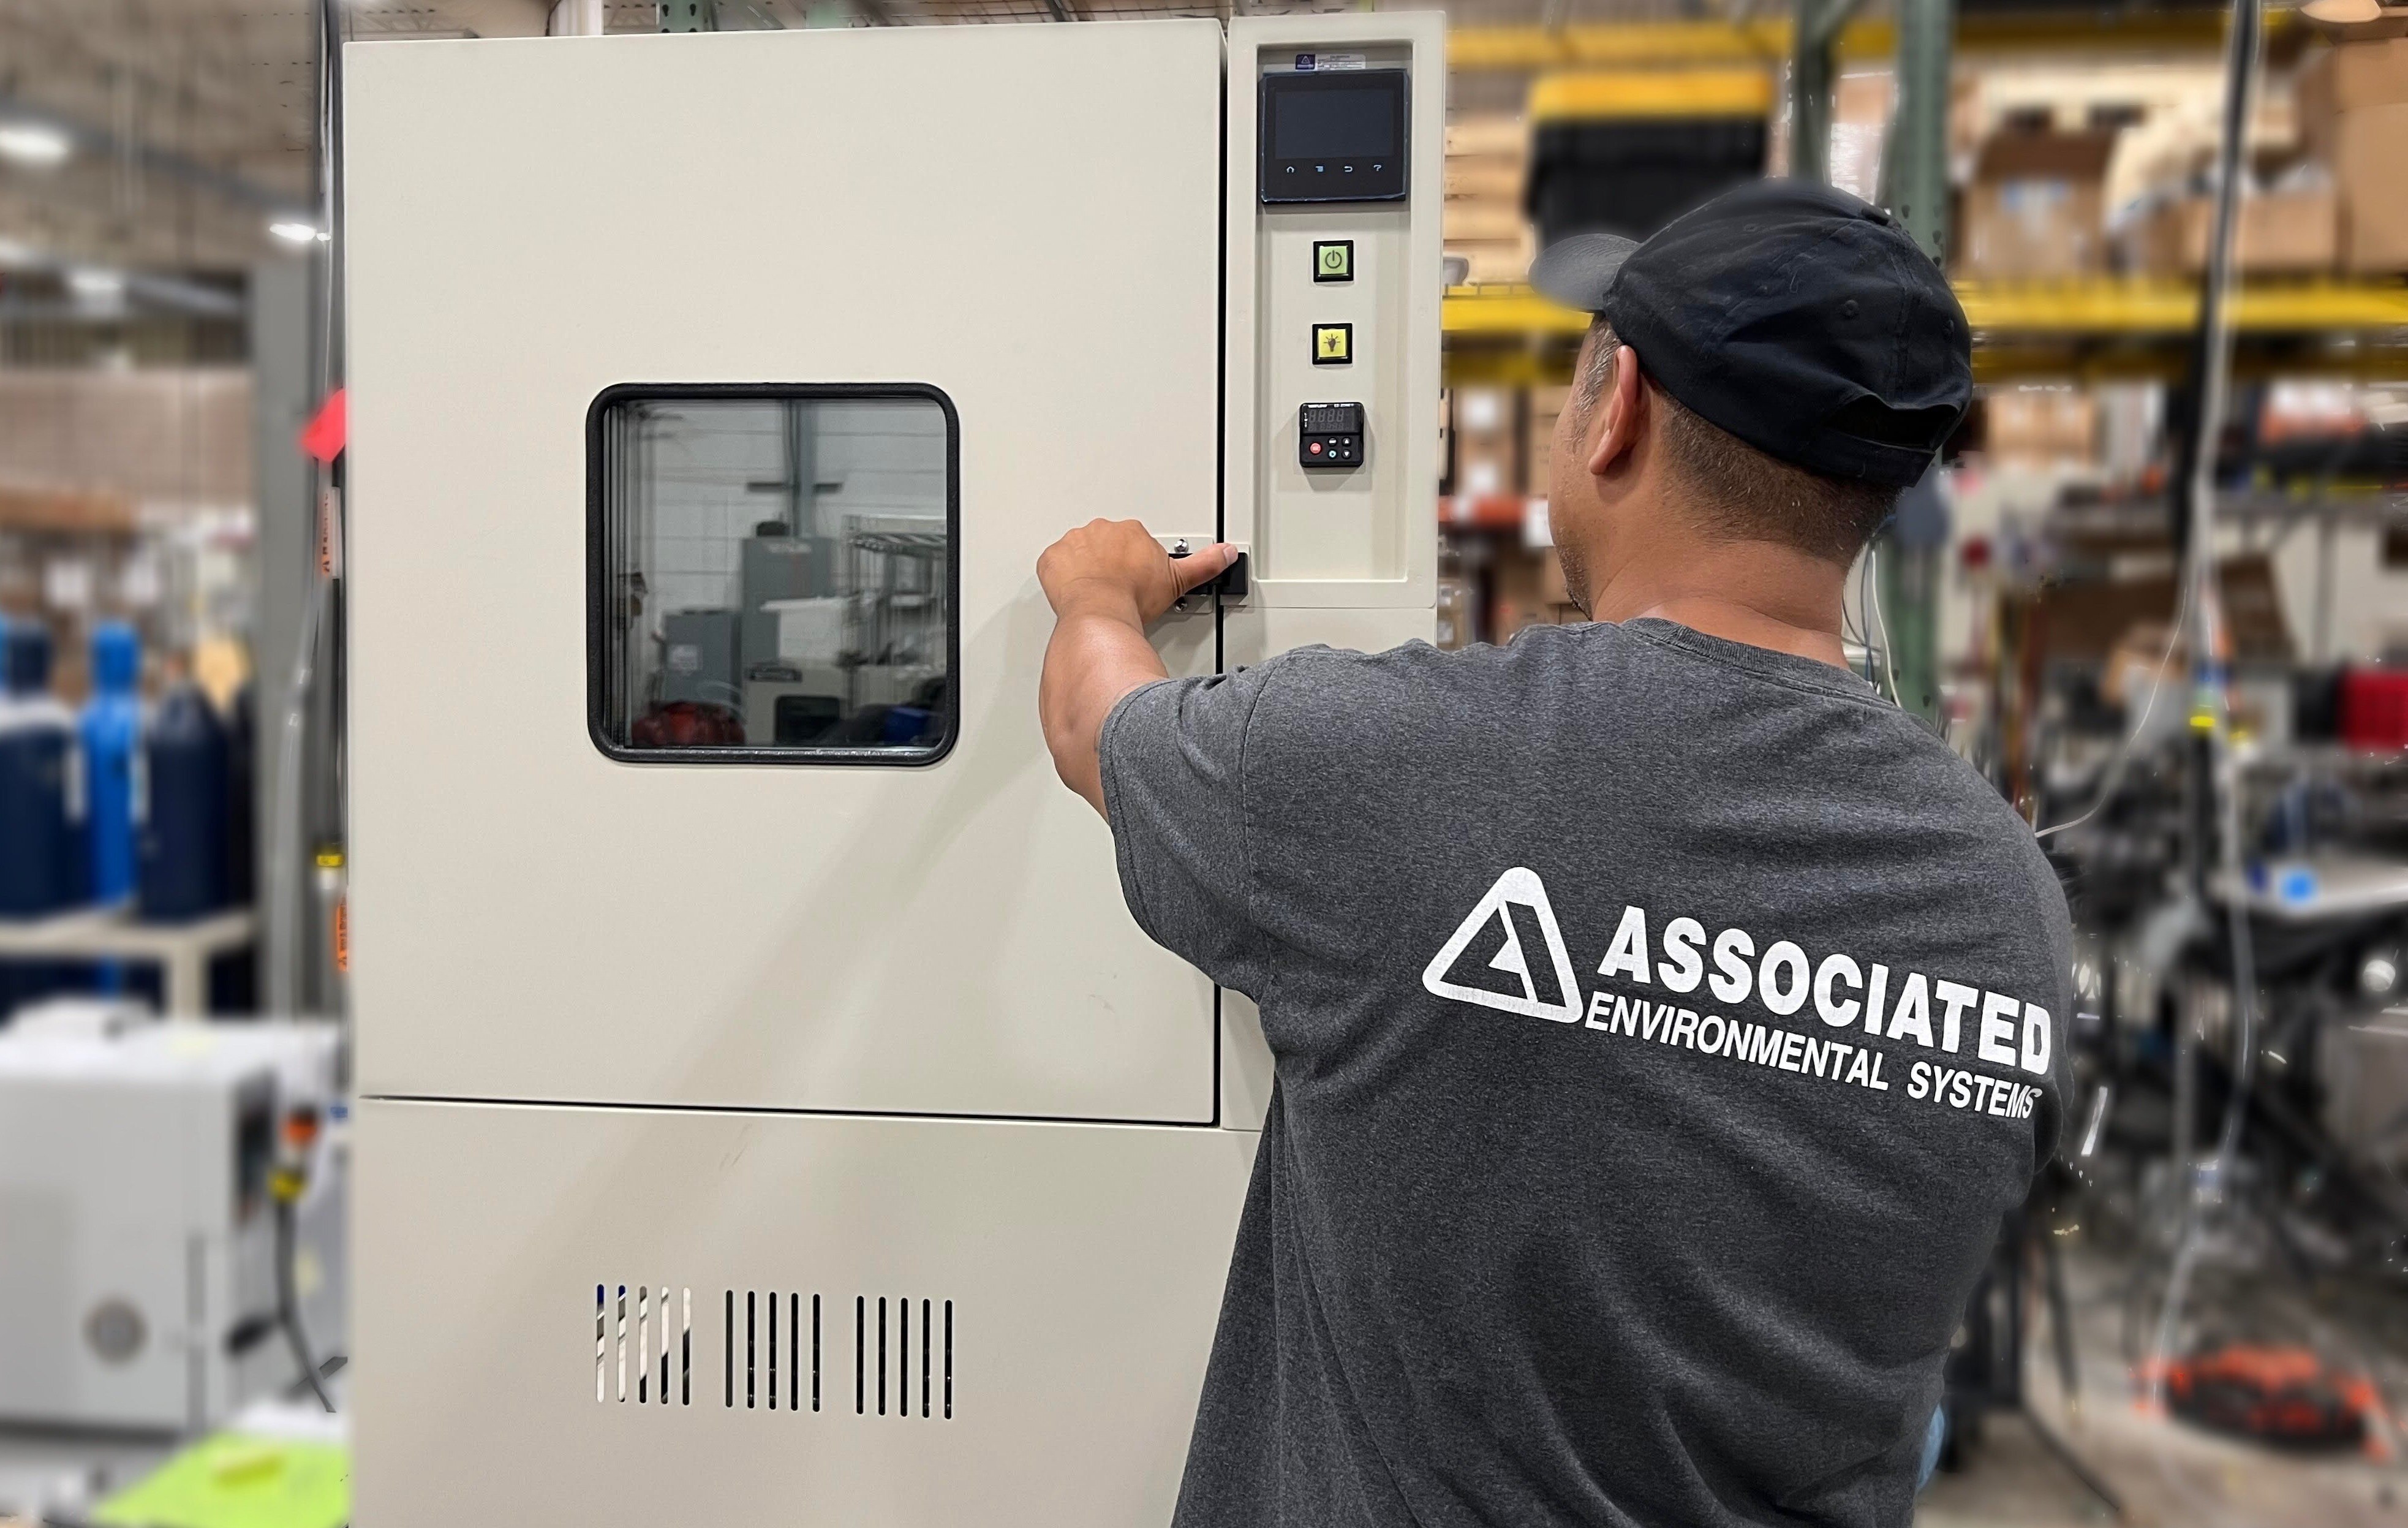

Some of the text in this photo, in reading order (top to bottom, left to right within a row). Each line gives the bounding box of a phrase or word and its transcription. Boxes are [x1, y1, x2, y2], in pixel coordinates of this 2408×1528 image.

[1585, 991, 2043, 1119] ENVIRONMENTAL SYSTEMS
[1597, 905, 2052, 1075] ASSOCIATED
